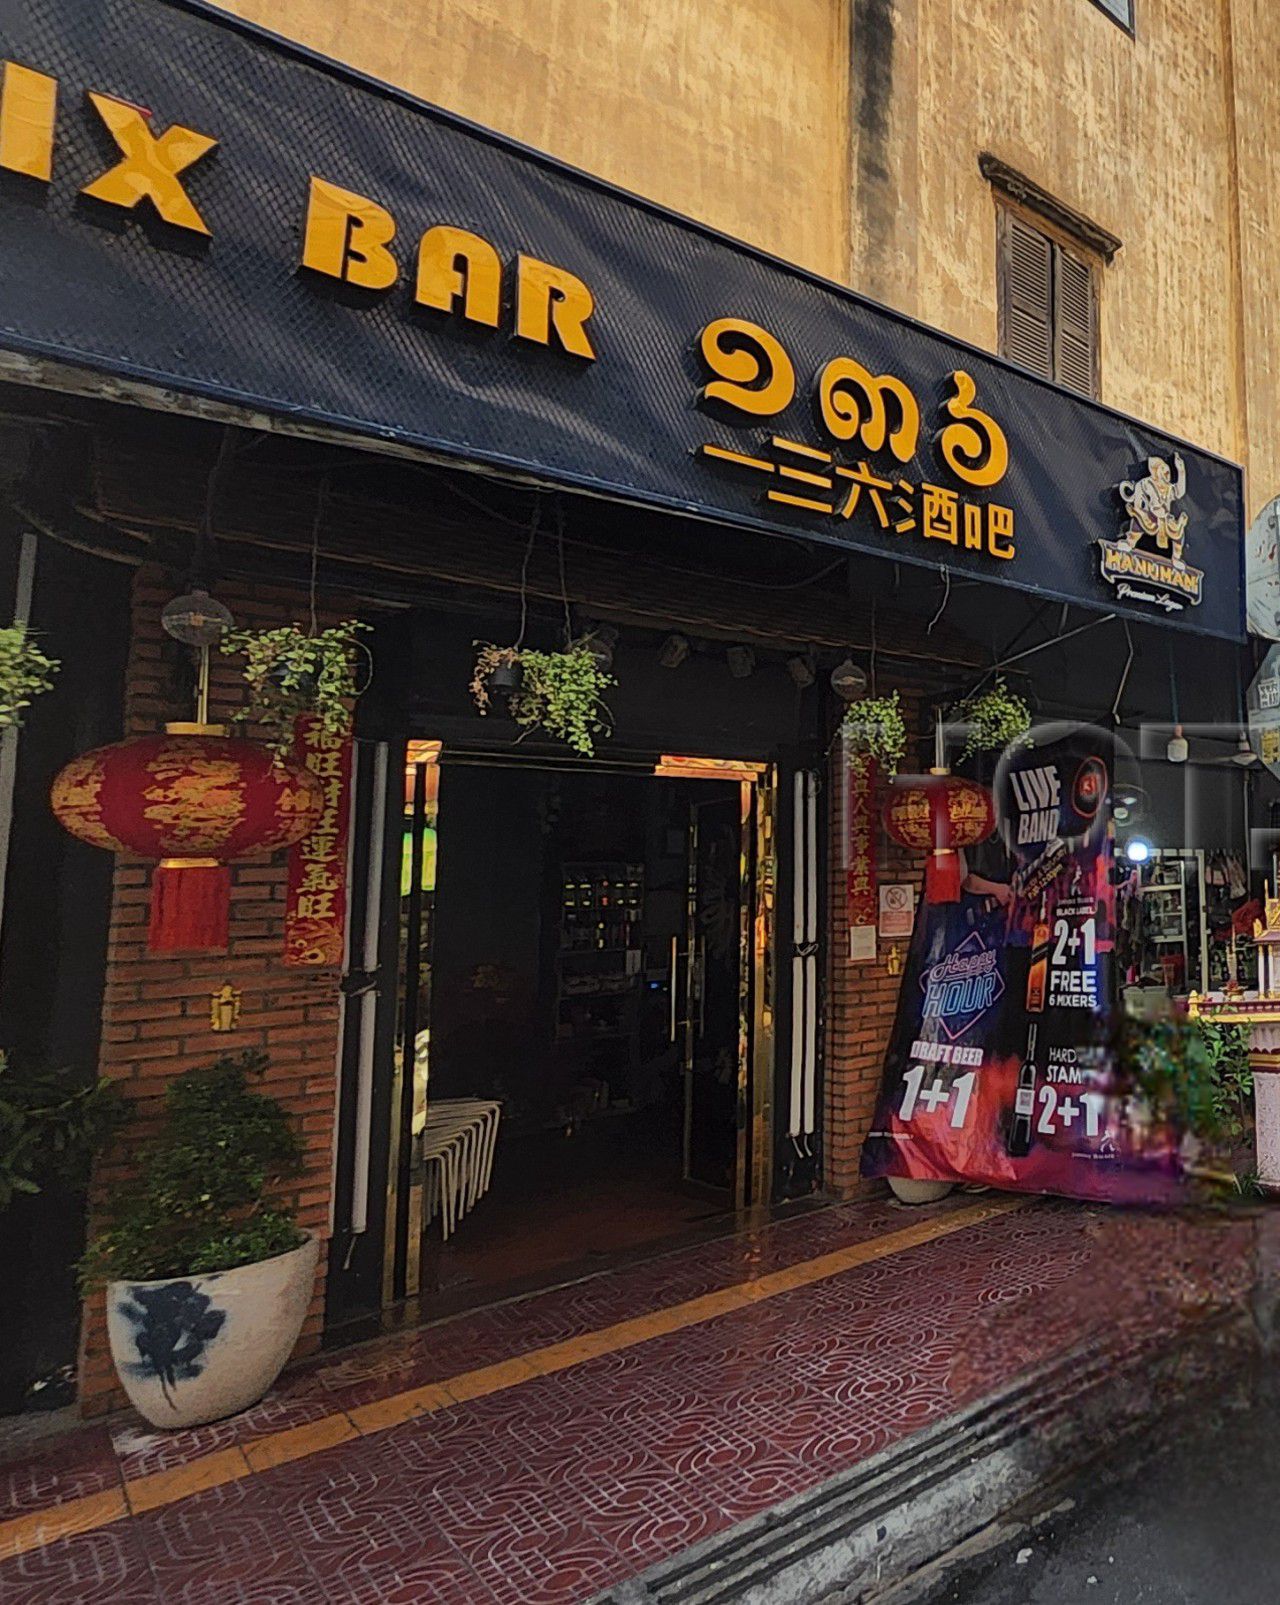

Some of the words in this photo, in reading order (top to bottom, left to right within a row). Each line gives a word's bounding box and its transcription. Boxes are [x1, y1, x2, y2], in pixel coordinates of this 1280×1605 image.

[302, 175, 596, 360] BAR
[700, 317, 1010, 487] ១៣៦
[703, 434, 1016, 560] 一三六酒吧
[1105, 547, 1199, 595] HANUMAN
[1009, 765, 1062, 812] LIVE
[1018, 809, 1060, 845] BAND
[1052, 918, 1096, 965] 2+1
[930, 950, 996, 982] Happy
[1050, 970, 1097, 993] FREE
[922, 971, 996, 1019] HOUR
[1049, 994, 1056, 1007] 6
[909, 1041, 953, 1065] DRAFT
[952, 1046, 984, 1067] BEER
[899, 1065, 976, 1129] 1+1
[1038, 1085, 1099, 1137] 2+1
